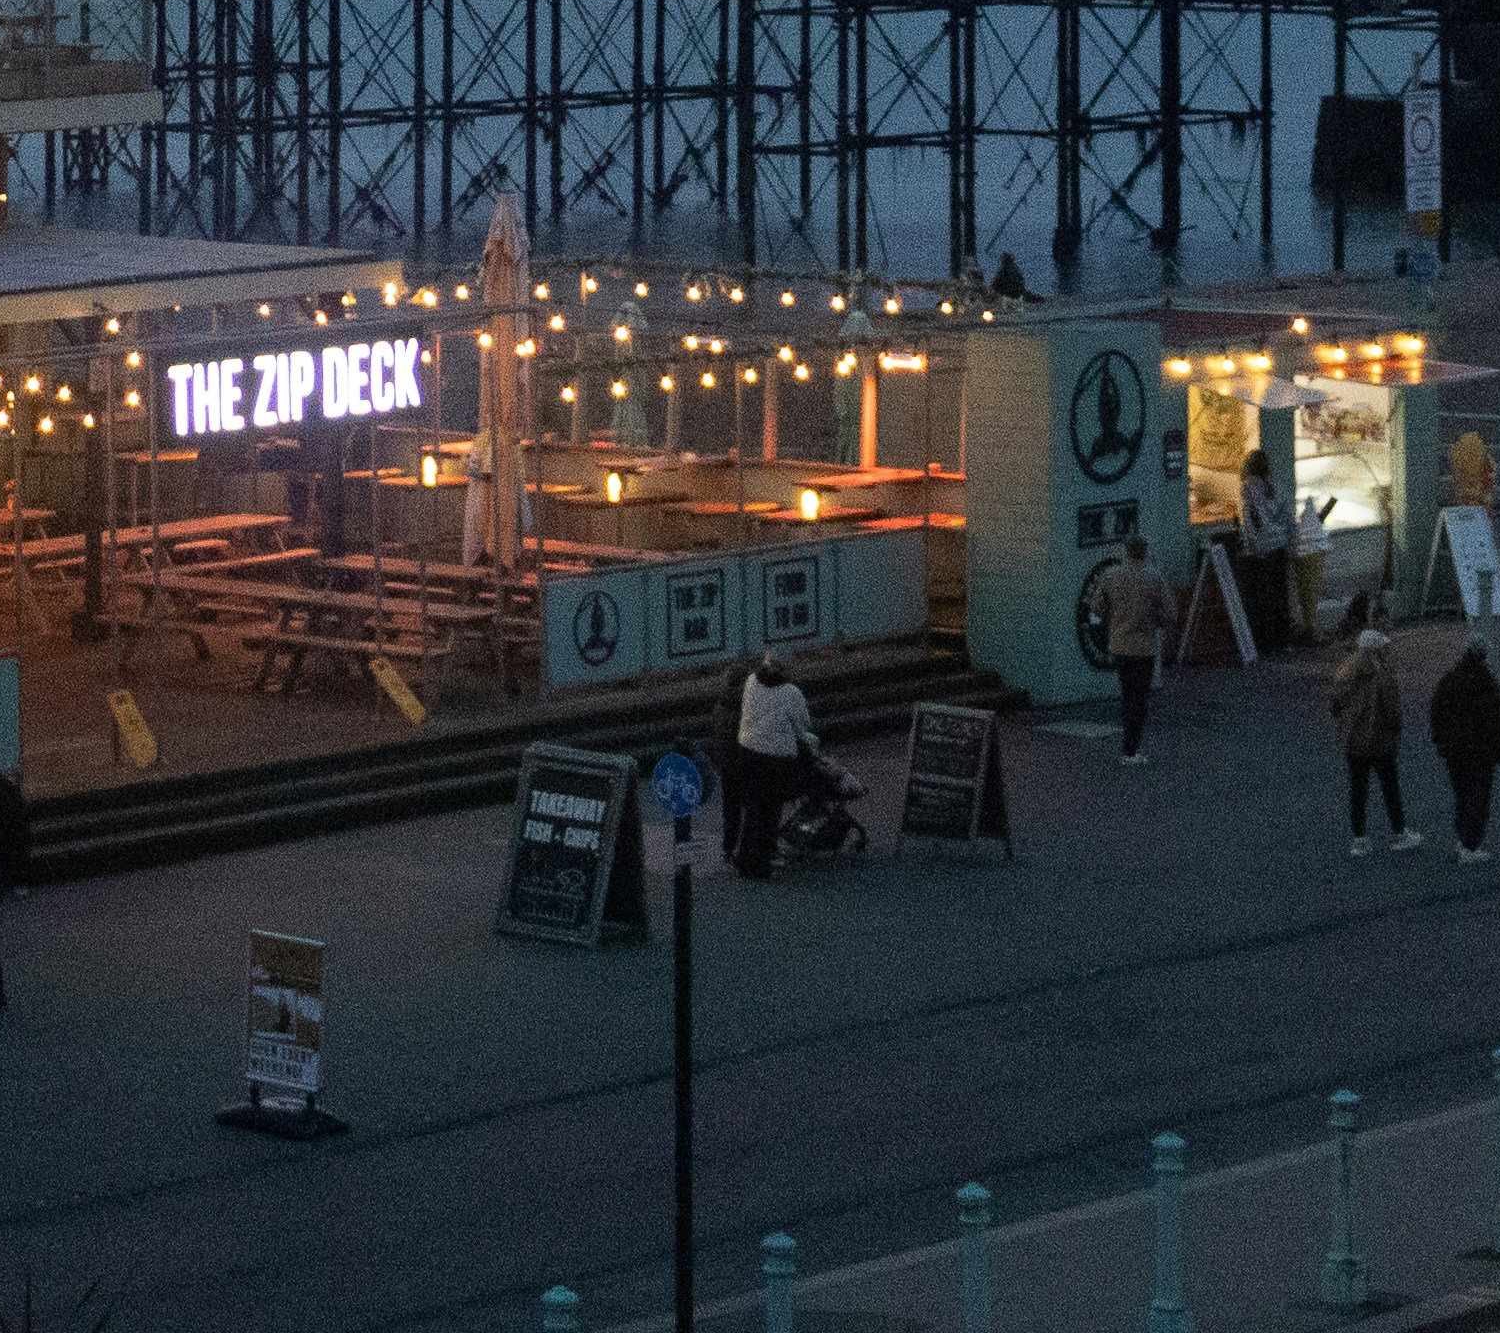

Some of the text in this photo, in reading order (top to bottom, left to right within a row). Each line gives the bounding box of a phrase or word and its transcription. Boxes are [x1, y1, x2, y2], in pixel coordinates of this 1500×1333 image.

[167, 336, 422, 437] THE ZIP DECK
